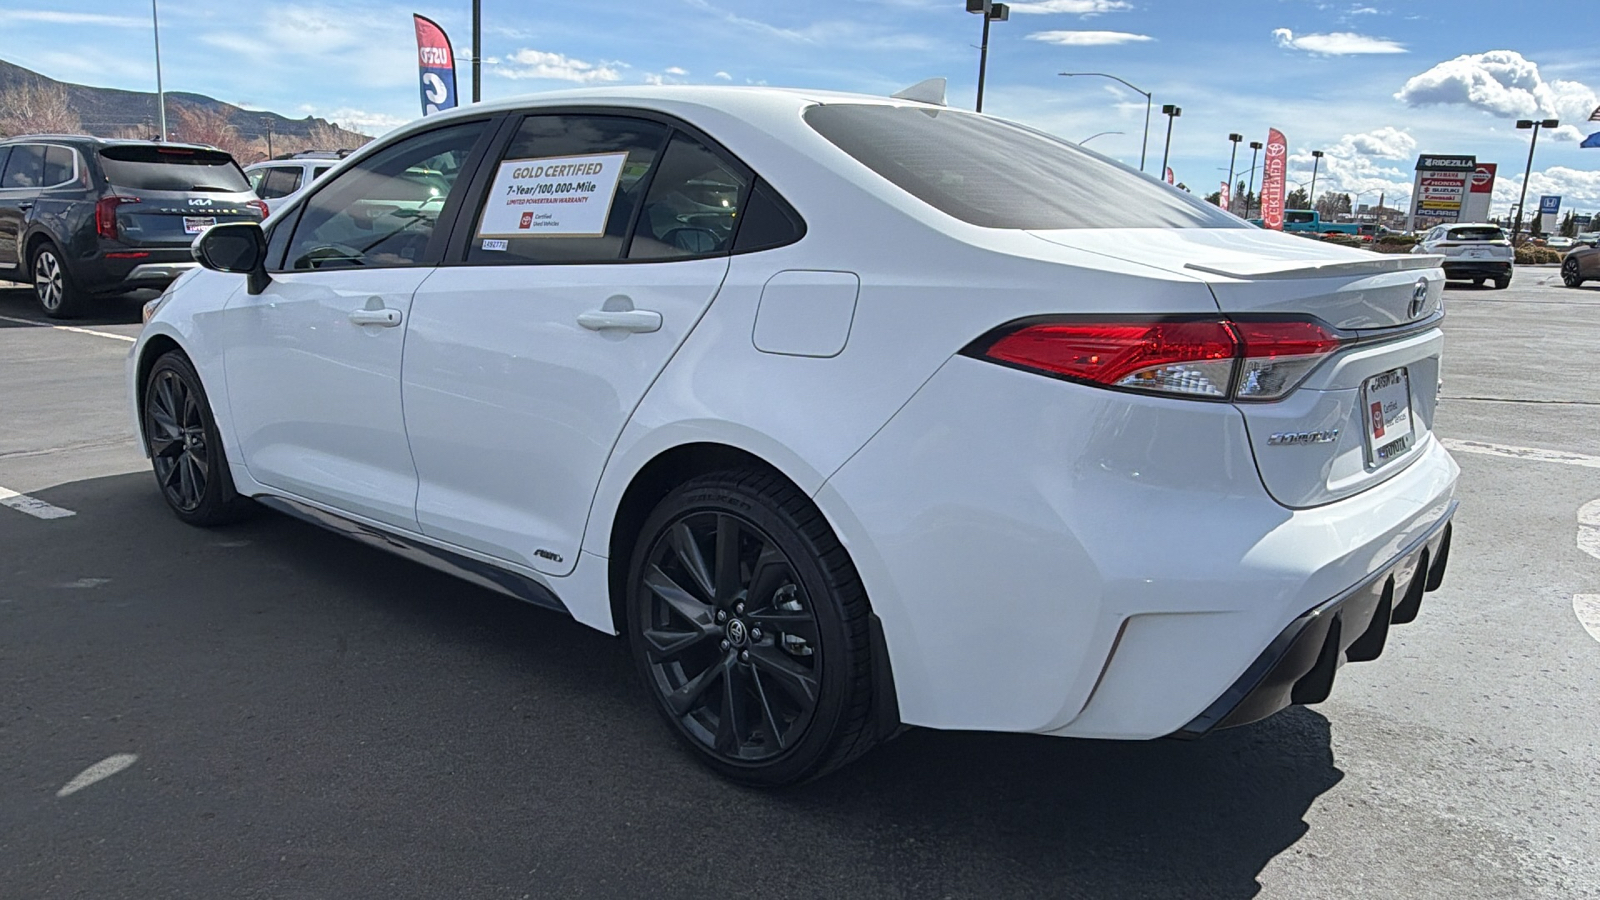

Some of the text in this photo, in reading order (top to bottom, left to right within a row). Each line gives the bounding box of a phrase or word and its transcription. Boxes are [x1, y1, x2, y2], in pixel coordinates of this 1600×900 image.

[1432, 159, 1473, 167] RIDEZILLA
[513, 162, 603, 179] GOLD CERTIFIED
[506, 181, 596, 196] 7-Year/100,000-Mile
[558, 196, 589, 204] WARRANTY
